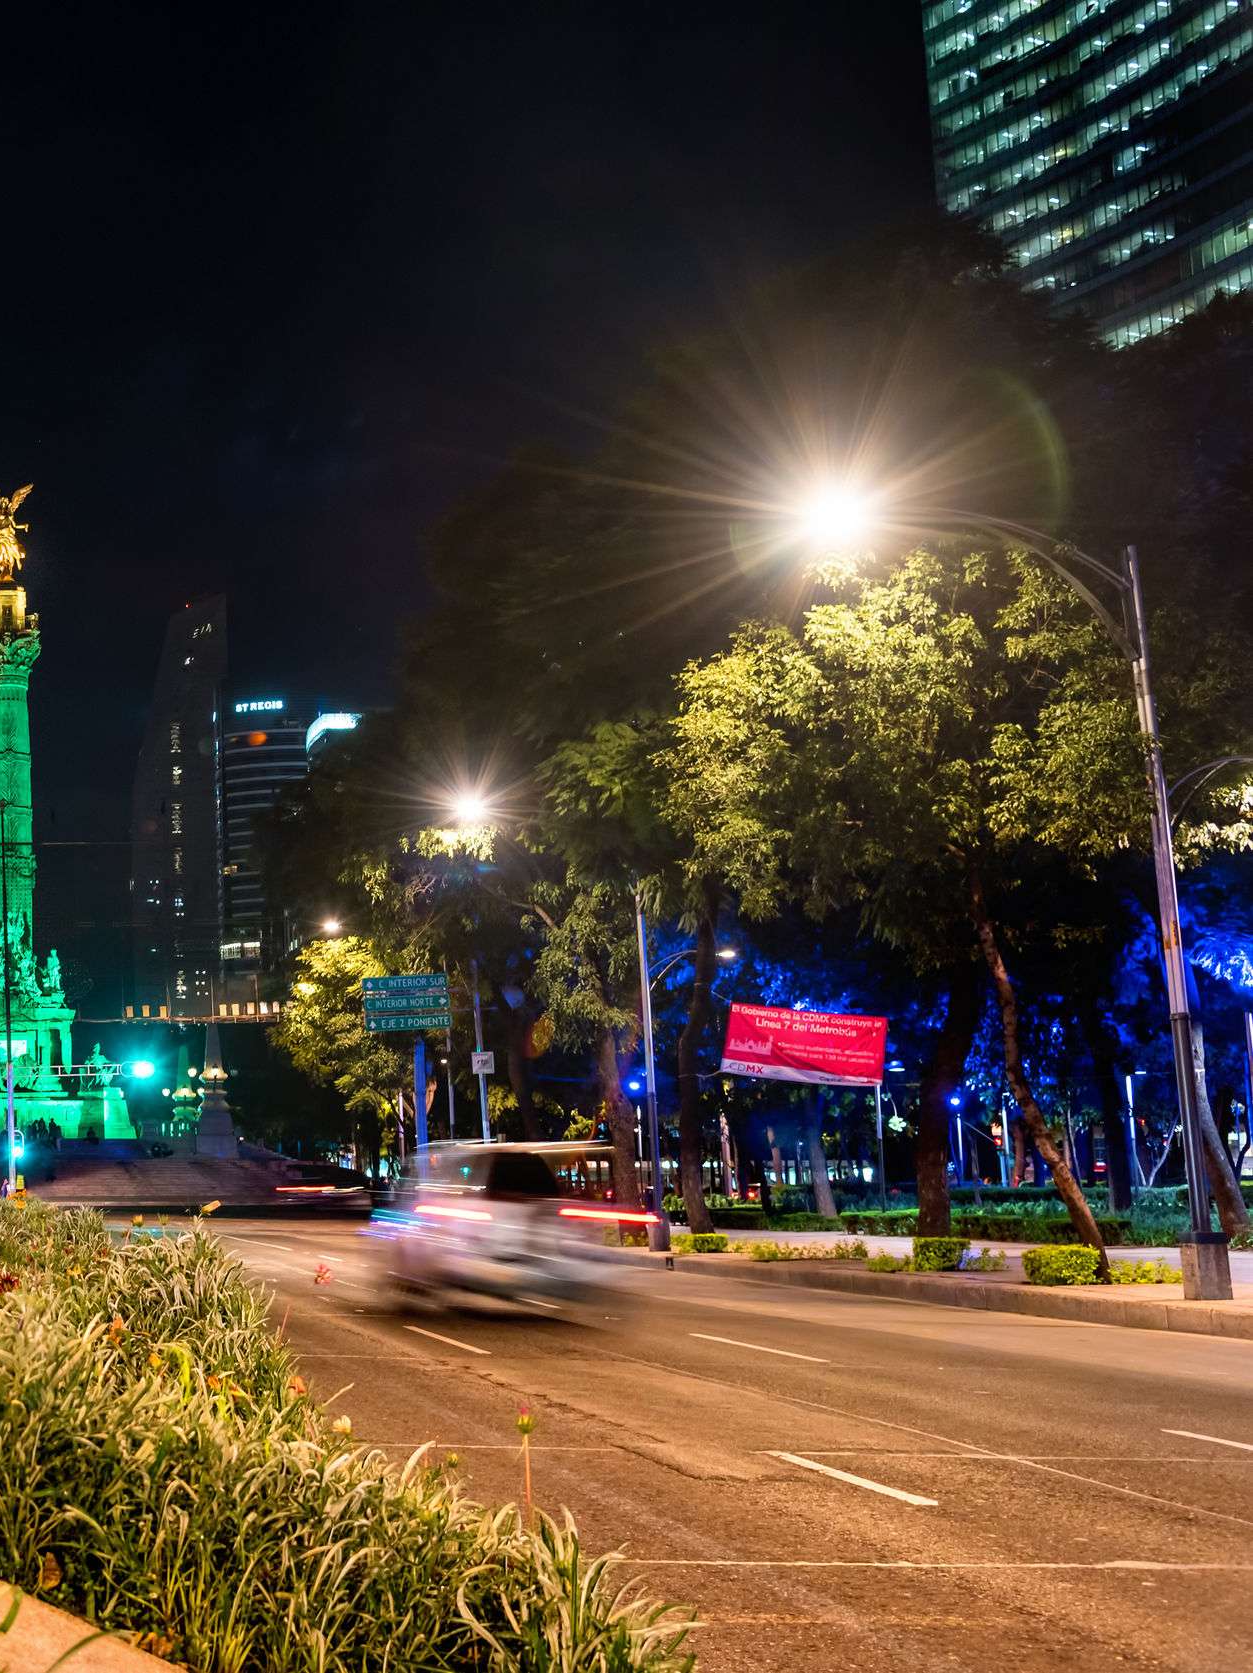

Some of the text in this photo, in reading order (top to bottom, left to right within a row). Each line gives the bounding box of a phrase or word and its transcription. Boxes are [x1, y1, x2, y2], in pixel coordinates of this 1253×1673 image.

[235, 701, 283, 713] ST REGIS
[388, 978, 426, 988] INTERIOR
[430, 977, 446, 986] SUR
[376, 999, 408, 1008] INTERIOR
[410, 997, 434, 1007] NORTE
[381, 1017, 450, 1029] EJE 2 PONIENTE
[741, 1006, 779, 1018] Gobierno
[802, 1013, 830, 1023] CDMX
[830, 1017, 872, 1028] construye
[784, 1021, 791, 1030] 7
[792, 1021, 808, 1032] del
[810, 1024, 857, 1037] Metrobús
[729, 1062, 763, 1074] CDMX
